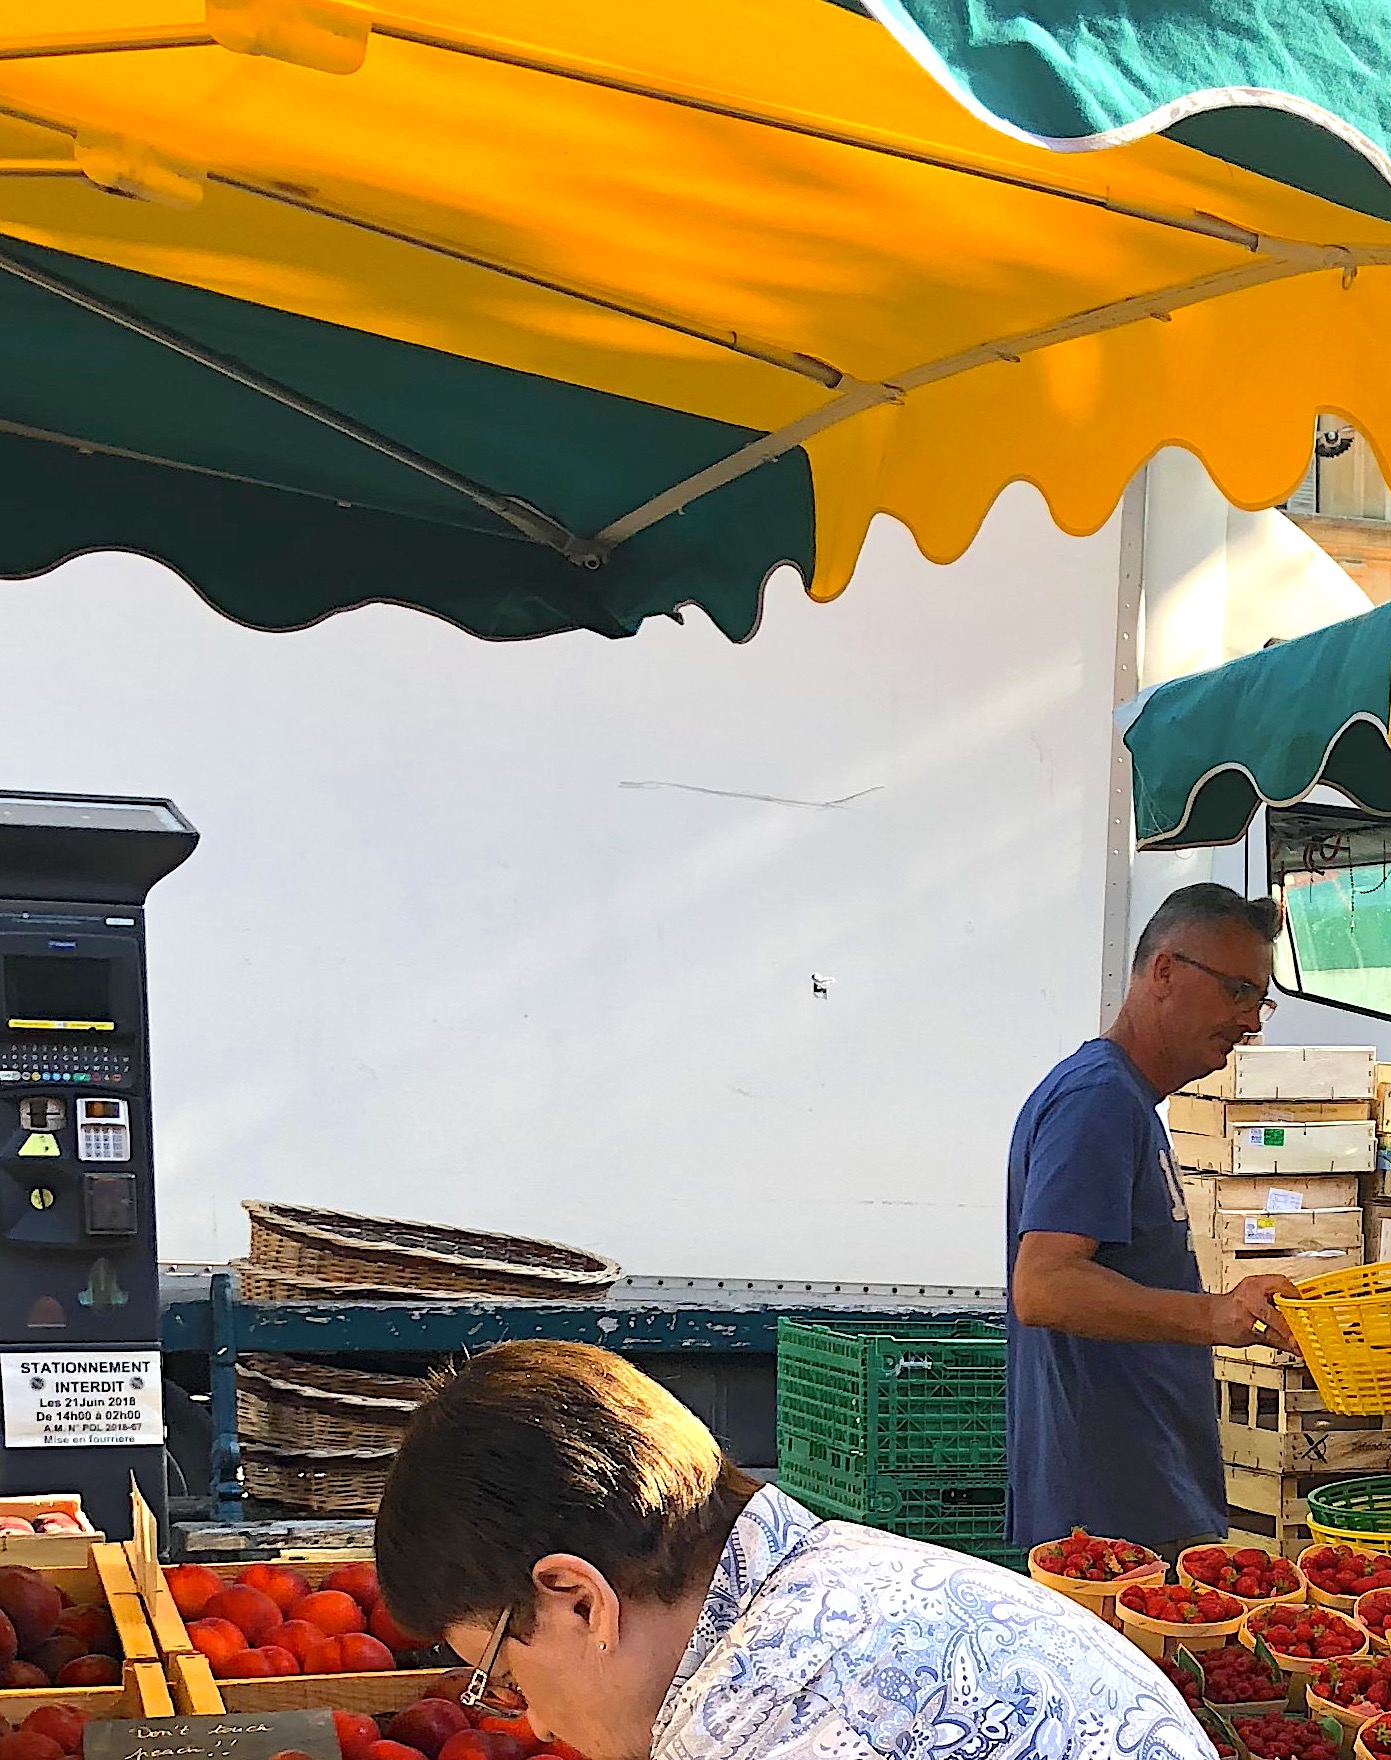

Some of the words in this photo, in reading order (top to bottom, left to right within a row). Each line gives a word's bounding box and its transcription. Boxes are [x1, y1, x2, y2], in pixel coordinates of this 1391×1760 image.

[20, 1361, 151, 1374] STATIONNEMENT
[55, 1381, 125, 1393] INTERDIT
[39, 1398, 62, 1408] Les
[108, 1397, 136, 1407] 2018
[36, 1411, 52, 1422] De
[56, 1411, 92, 1421] 14h00
[105, 1410, 141, 1420] 02h00
[44, 1435, 70, 1444] Mise
[128, 1723, 190, 1740] Don't
[207, 1722, 275, 1736] touch
